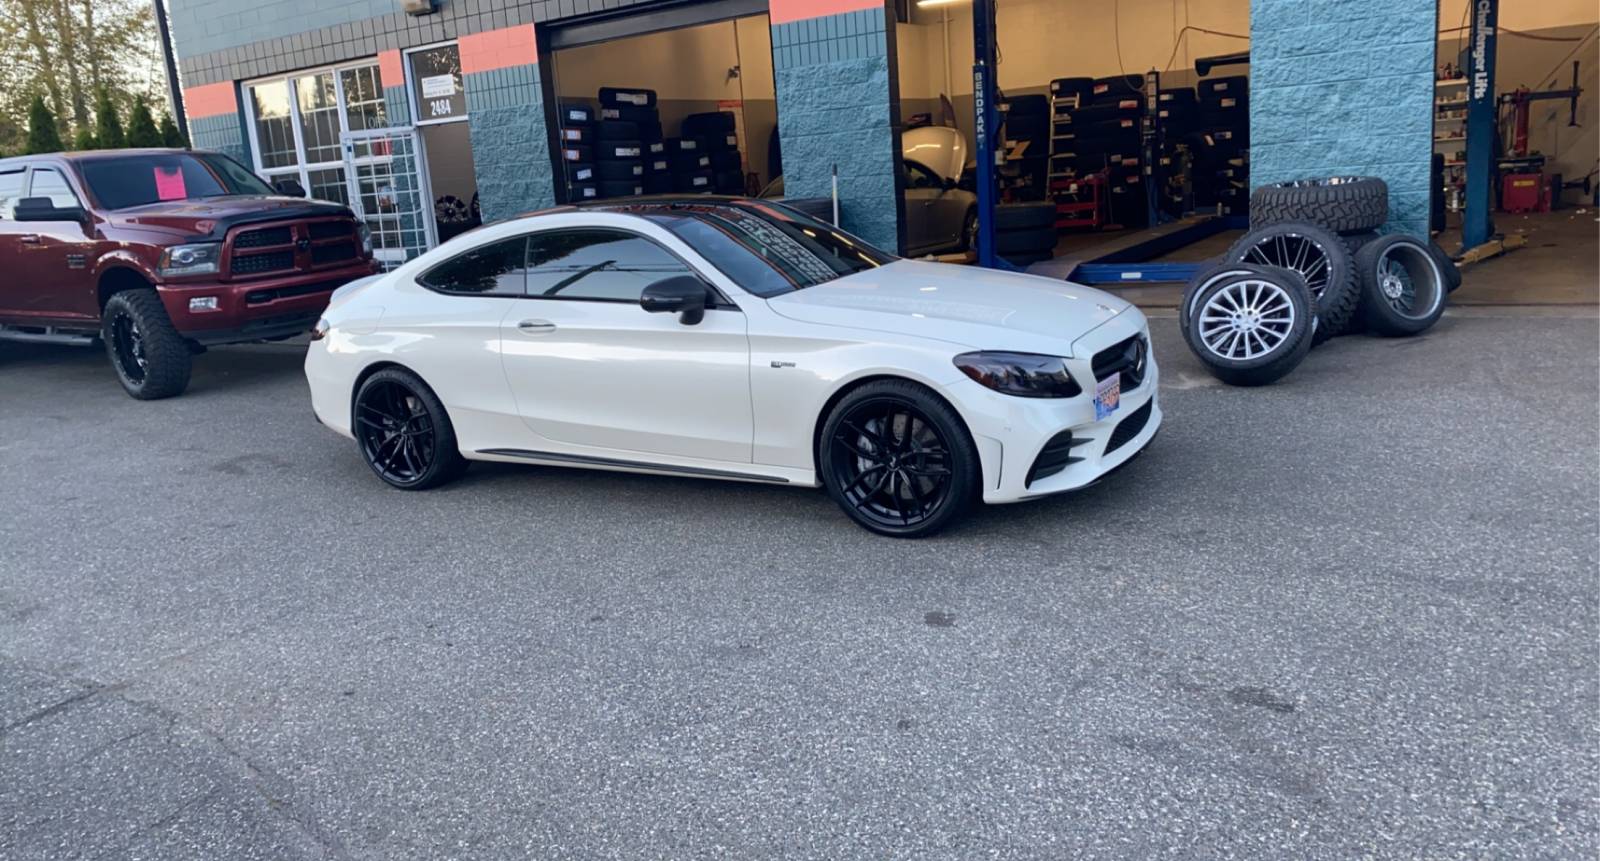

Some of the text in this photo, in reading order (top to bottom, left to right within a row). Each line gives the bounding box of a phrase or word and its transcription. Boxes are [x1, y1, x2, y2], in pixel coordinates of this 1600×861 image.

[1472, 0, 1493, 99] Challenger Lifts
[430, 99, 451, 116] 2484
